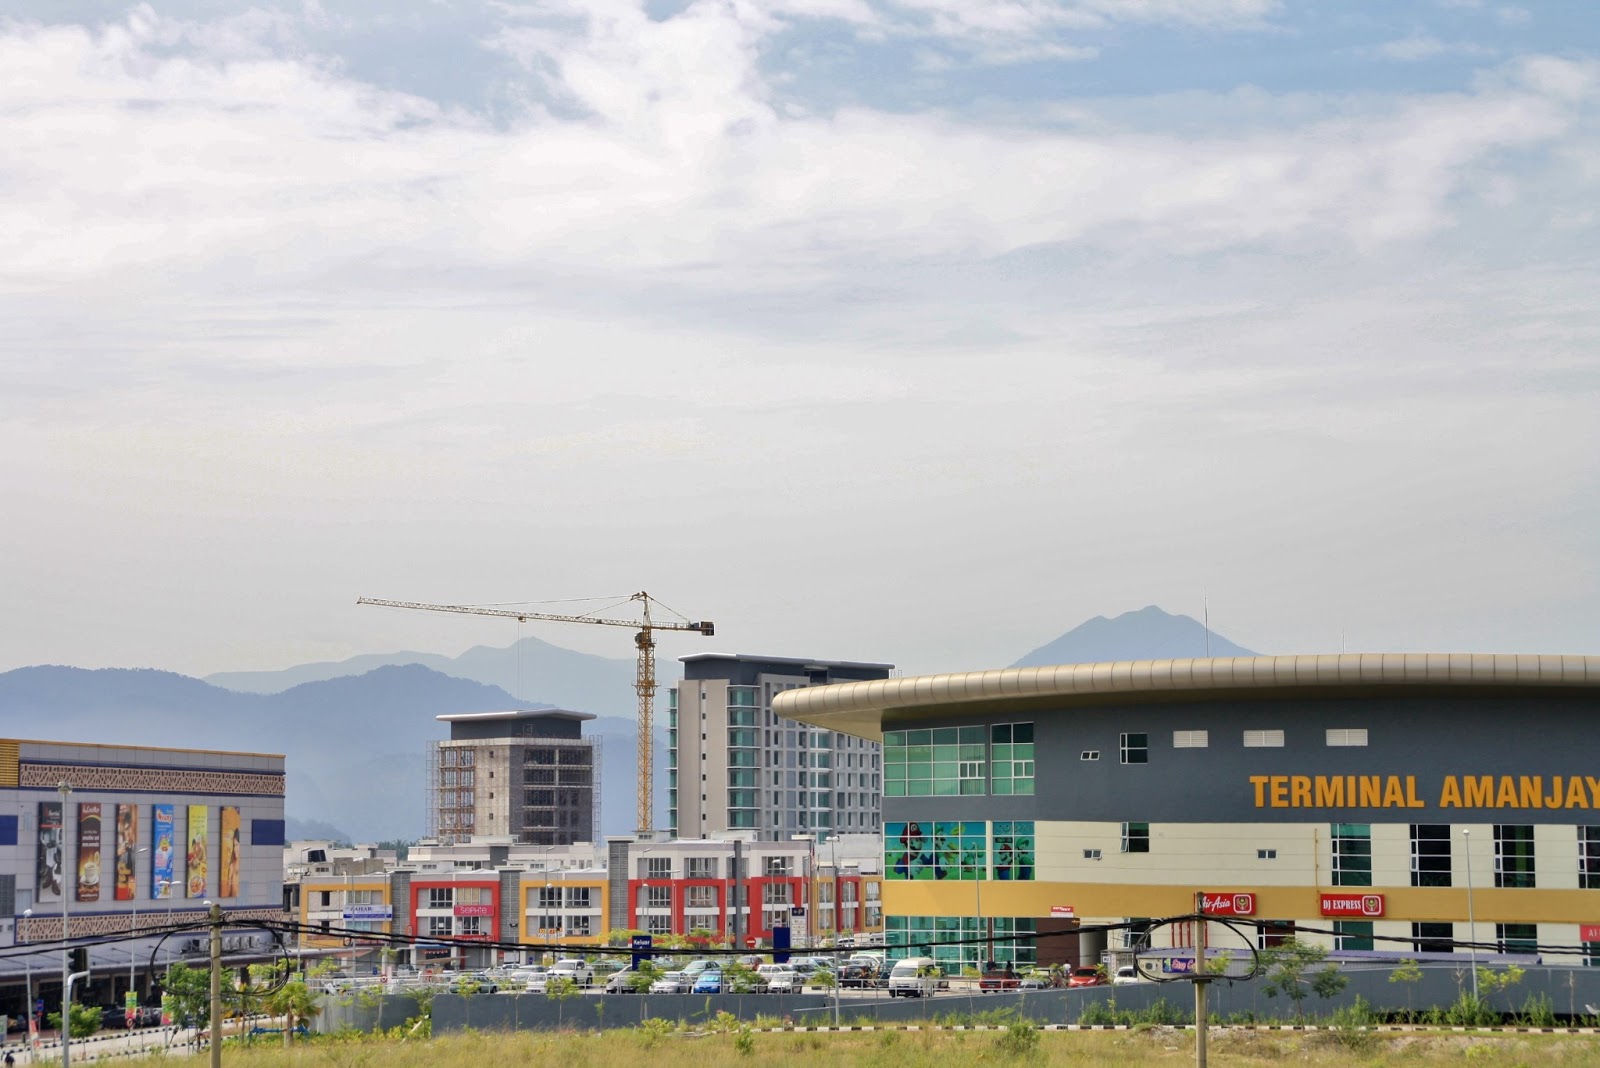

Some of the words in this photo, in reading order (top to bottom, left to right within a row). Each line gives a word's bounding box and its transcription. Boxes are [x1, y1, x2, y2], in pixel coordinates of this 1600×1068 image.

[1249, 775, 1425, 808] TERMINAL
[1323, 900, 1331, 910] DJ
[1333, 900, 1361, 910] EXPRESS
